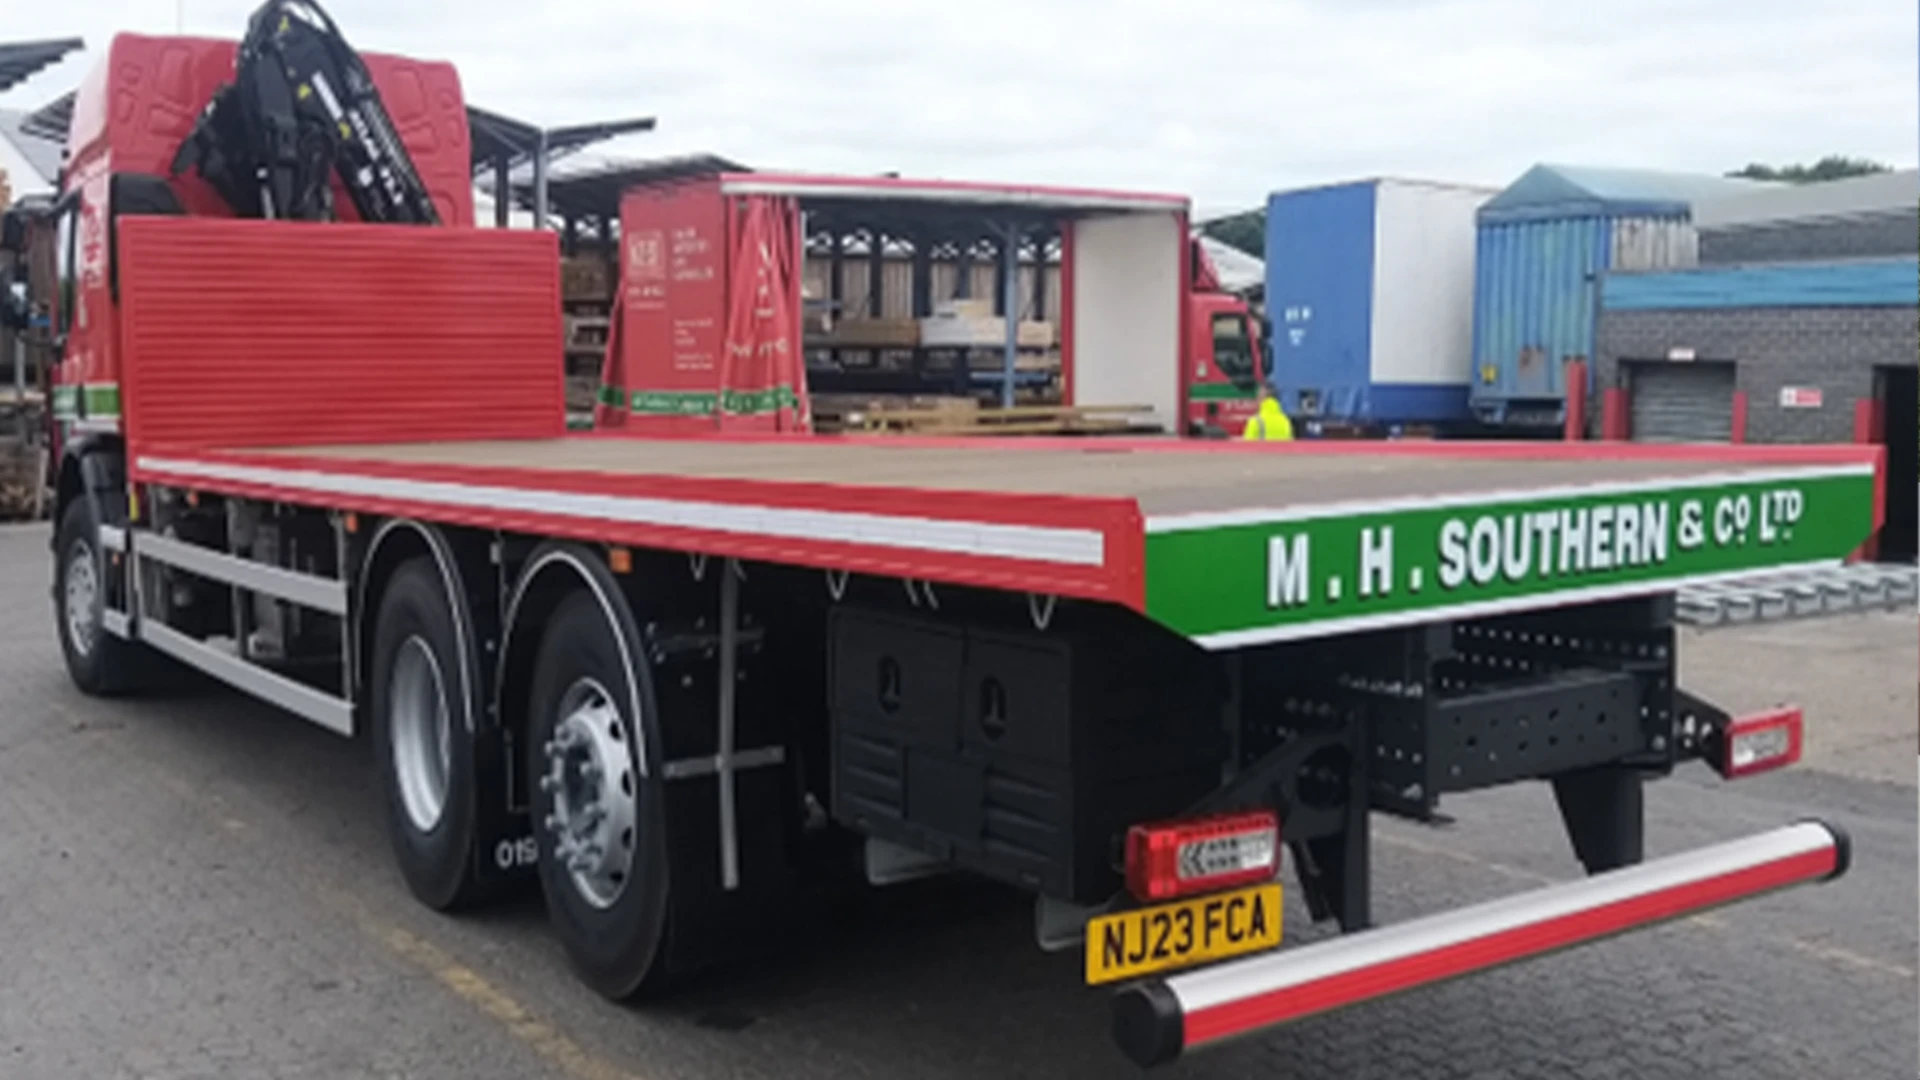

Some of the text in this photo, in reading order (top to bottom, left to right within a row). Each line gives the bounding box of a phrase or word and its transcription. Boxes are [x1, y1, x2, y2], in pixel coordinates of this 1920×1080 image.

[1439, 503, 1667, 587] SOUTHERN
[1679, 500, 1704, 547] &
[1103, 893, 1266, 968] NJ23 FCA
